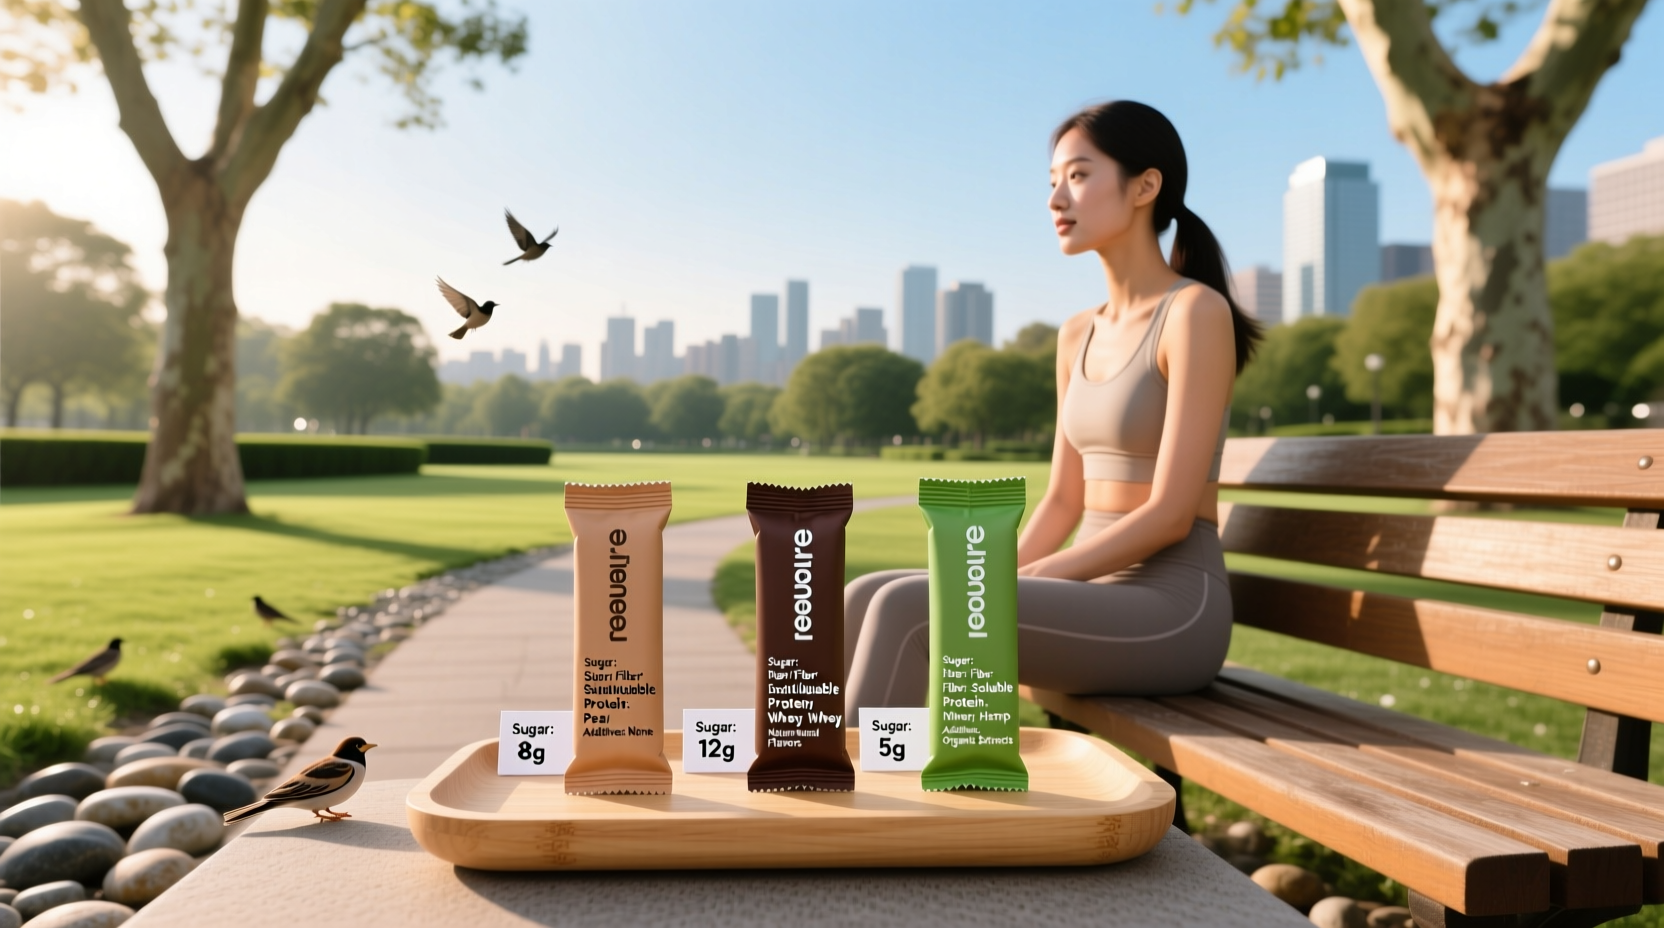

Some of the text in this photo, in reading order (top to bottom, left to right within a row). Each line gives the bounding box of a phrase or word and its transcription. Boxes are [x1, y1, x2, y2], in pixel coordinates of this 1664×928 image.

[512, 722, 554, 738] Sugar:
[695, 720, 737, 736] Sugar:
[872, 719, 912, 735] Sugar:
[517, 740, 546, 766] 8g
[698, 738, 735, 763] 12g
[879, 737, 906, 762] 5g
